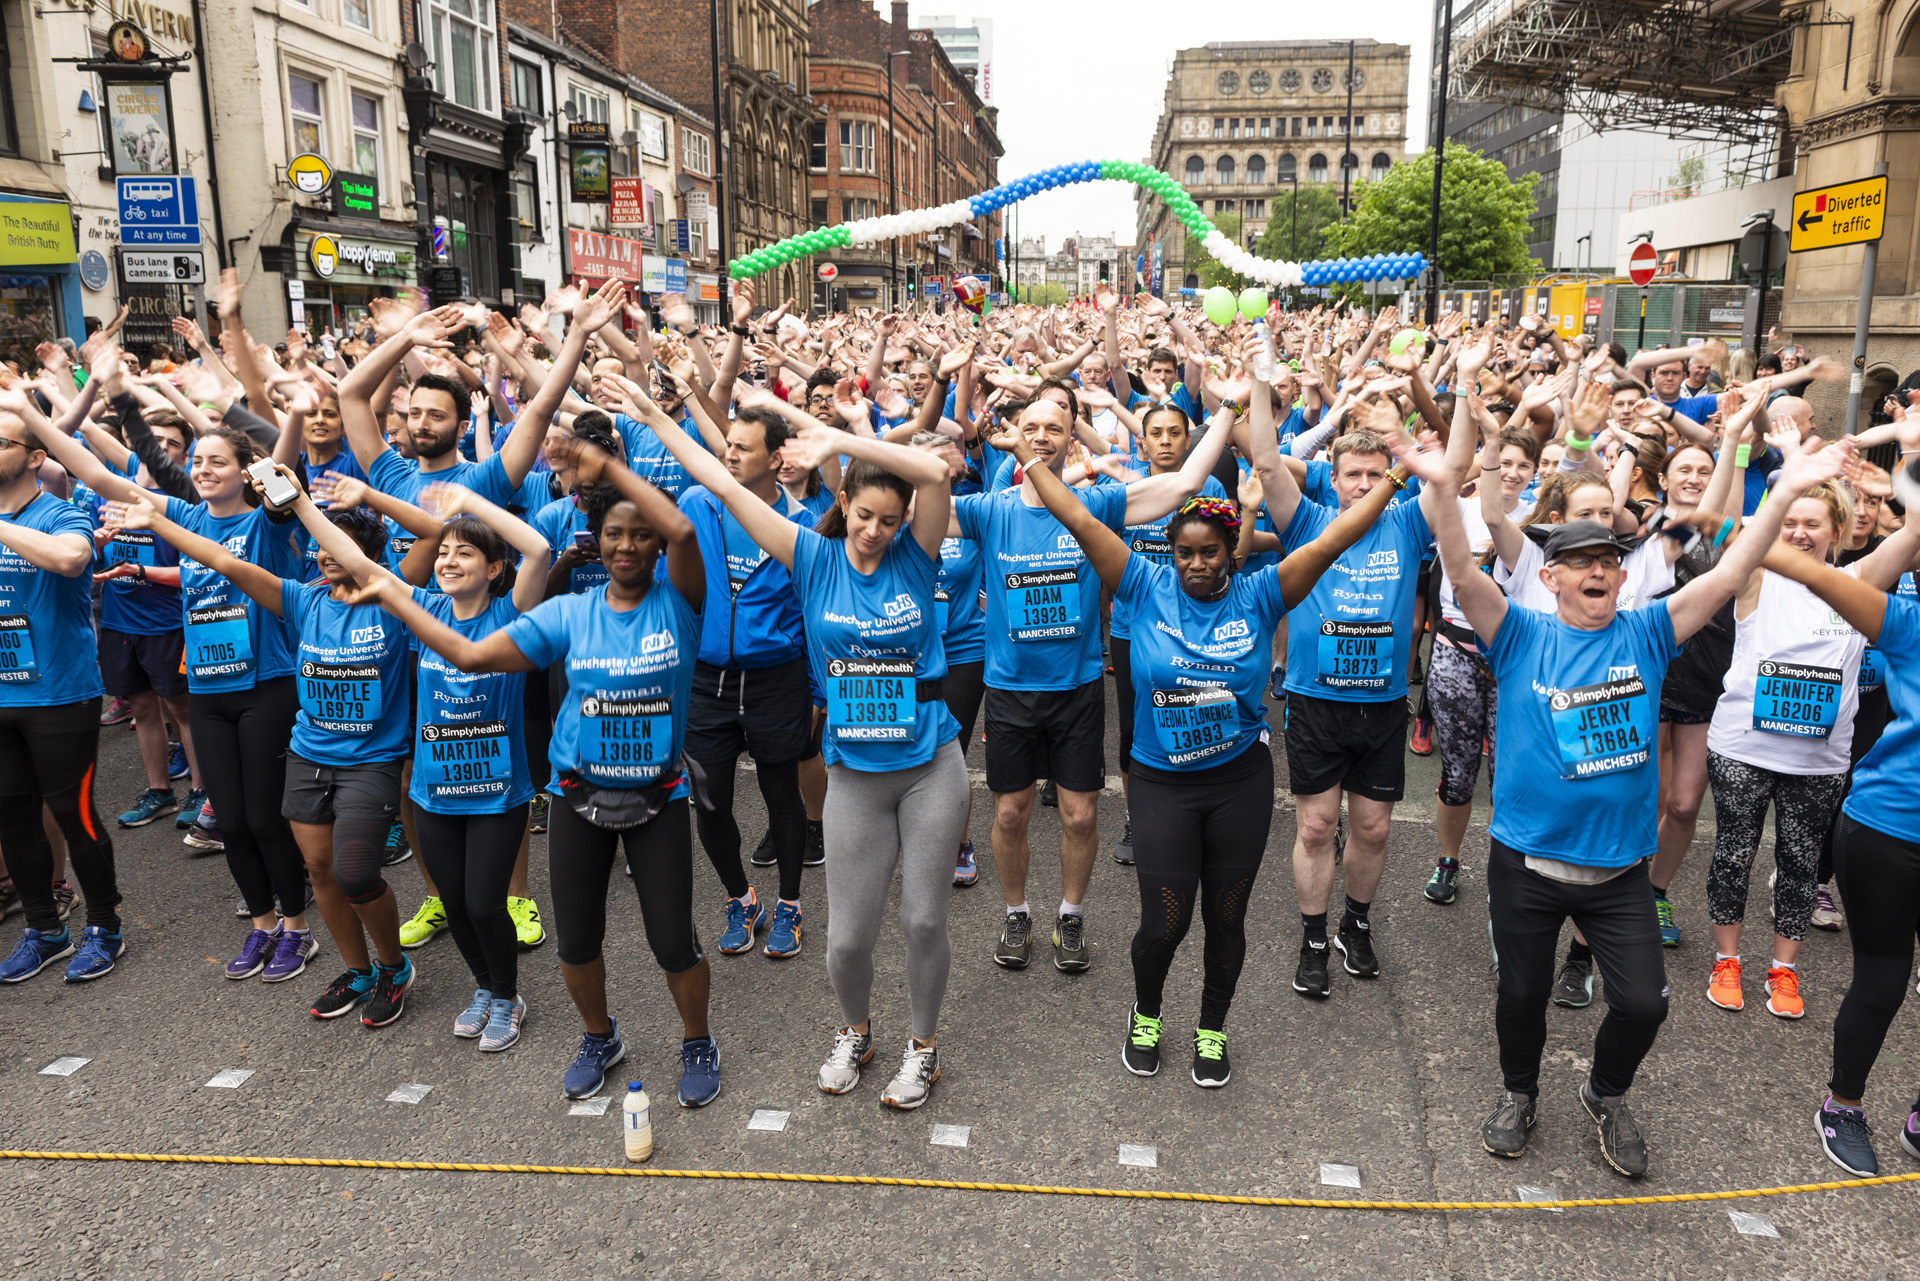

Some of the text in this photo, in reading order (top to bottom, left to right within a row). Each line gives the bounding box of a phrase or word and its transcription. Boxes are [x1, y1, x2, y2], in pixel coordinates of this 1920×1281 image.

[116, 94, 158, 104] CIRCUS
[118, 105, 160, 115] TAVERN
[1828, 188, 1882, 213] Diverted
[151, 208, 169, 218] taxi
[2, 215, 60, 232] The Beautiful
[1832, 216, 1871, 234] traffic
[8, 234, 60, 252] British Butty
[134, 230, 187, 241] At any time
[574, 232, 632, 262] JANAM
[128, 257, 168, 266] Bus lane
[129, 270, 168, 278] cameras
[128, 296, 180, 314] CIRCUS
[112, 543, 138, 559] OWEN
[998, 552, 1043, 562] Mnchester
[1368, 550, 1397, 566] NHS
[576, 572, 612, 580] Ryma
[1022, 571, 1076, 584] Simplyhealth
[1024, 586, 1062, 606] ADAM
[1332, 588, 1384, 600] Ryman
[884, 594, 917, 616] NHS
[1337, 604, 1379, 614] #TeamMFT
[192, 607, 245, 622] Simplyhealth
[874, 609, 922, 628] University
[1024, 606, 1067, 626] 13928
[352, 625, 385, 644] NHS
[871, 625, 910, 637] Foundation
[1018, 626, 1076, 639] MANCHESTER
[1214, 619, 1248, 640] NHS
[1337, 624, 1392, 636] Simplyhealth
[340, 642, 386, 655] University
[642, 629, 674, 654] NHS
[1204, 637, 1252, 653] University
[1336, 638, 1377, 656] KEVIN
[198, 642, 236, 662] 17005
[336, 654, 374, 663] Foundation
[571, 648, 679, 672] Manchester University
[195, 662, 248, 676] MANCHESTER
[316, 666, 378, 678] Simplyhealth
[609, 667, 624, 677] NHS
[626, 663, 667, 676] Foundation
[848, 662, 914, 677] Simplyhealth
[1170, 656, 1236, 672] Ryman
[1333, 658, 1378, 675] 13873
[456, 673, 490, 682] Foundation
[1778, 666, 1842, 681] Simplyhealth
[838, 679, 904, 699] HIDATSA
[1326, 677, 1385, 688] MANCHESTER
[306, 680, 370, 702] DIMPLE
[433, 690, 488, 705] Ryman
[595, 684, 662, 702] Ryman
[1168, 688, 1233, 704] Simplyhealth
[1573, 681, 1644, 704] Simplyhealth
[1762, 678, 1835, 704] JENNIFER
[316, 701, 364, 720] 16979
[440, 709, 482, 720] #TeamMFT
[602, 700, 670, 717] Simplyhealth
[845, 703, 898, 722] 13933
[1157, 703, 1233, 728] IJEOMA FLORENCE
[1578, 701, 1632, 732] JERRY
[1770, 700, 1822, 722] 16206
[313, 718, 374, 732] MANCHESTER
[442, 724, 506, 738] Simplyhealth
[601, 719, 652, 740] HELEN
[837, 728, 907, 738] MANCHESTER
[1760, 720, 1827, 736] MANCHESTER
[1172, 723, 1223, 750] 13893
[1579, 726, 1640, 757] 13684
[432, 738, 501, 762] MARTINA
[599, 742, 653, 762] 13886
[1168, 740, 1234, 765] MANCHESTER
[590, 764, 662, 777] MANCHESTER
[1576, 750, 1648, 776] MANCHESTER
[442, 761, 494, 782] 13901
[436, 782, 504, 796] MANCHESTER
